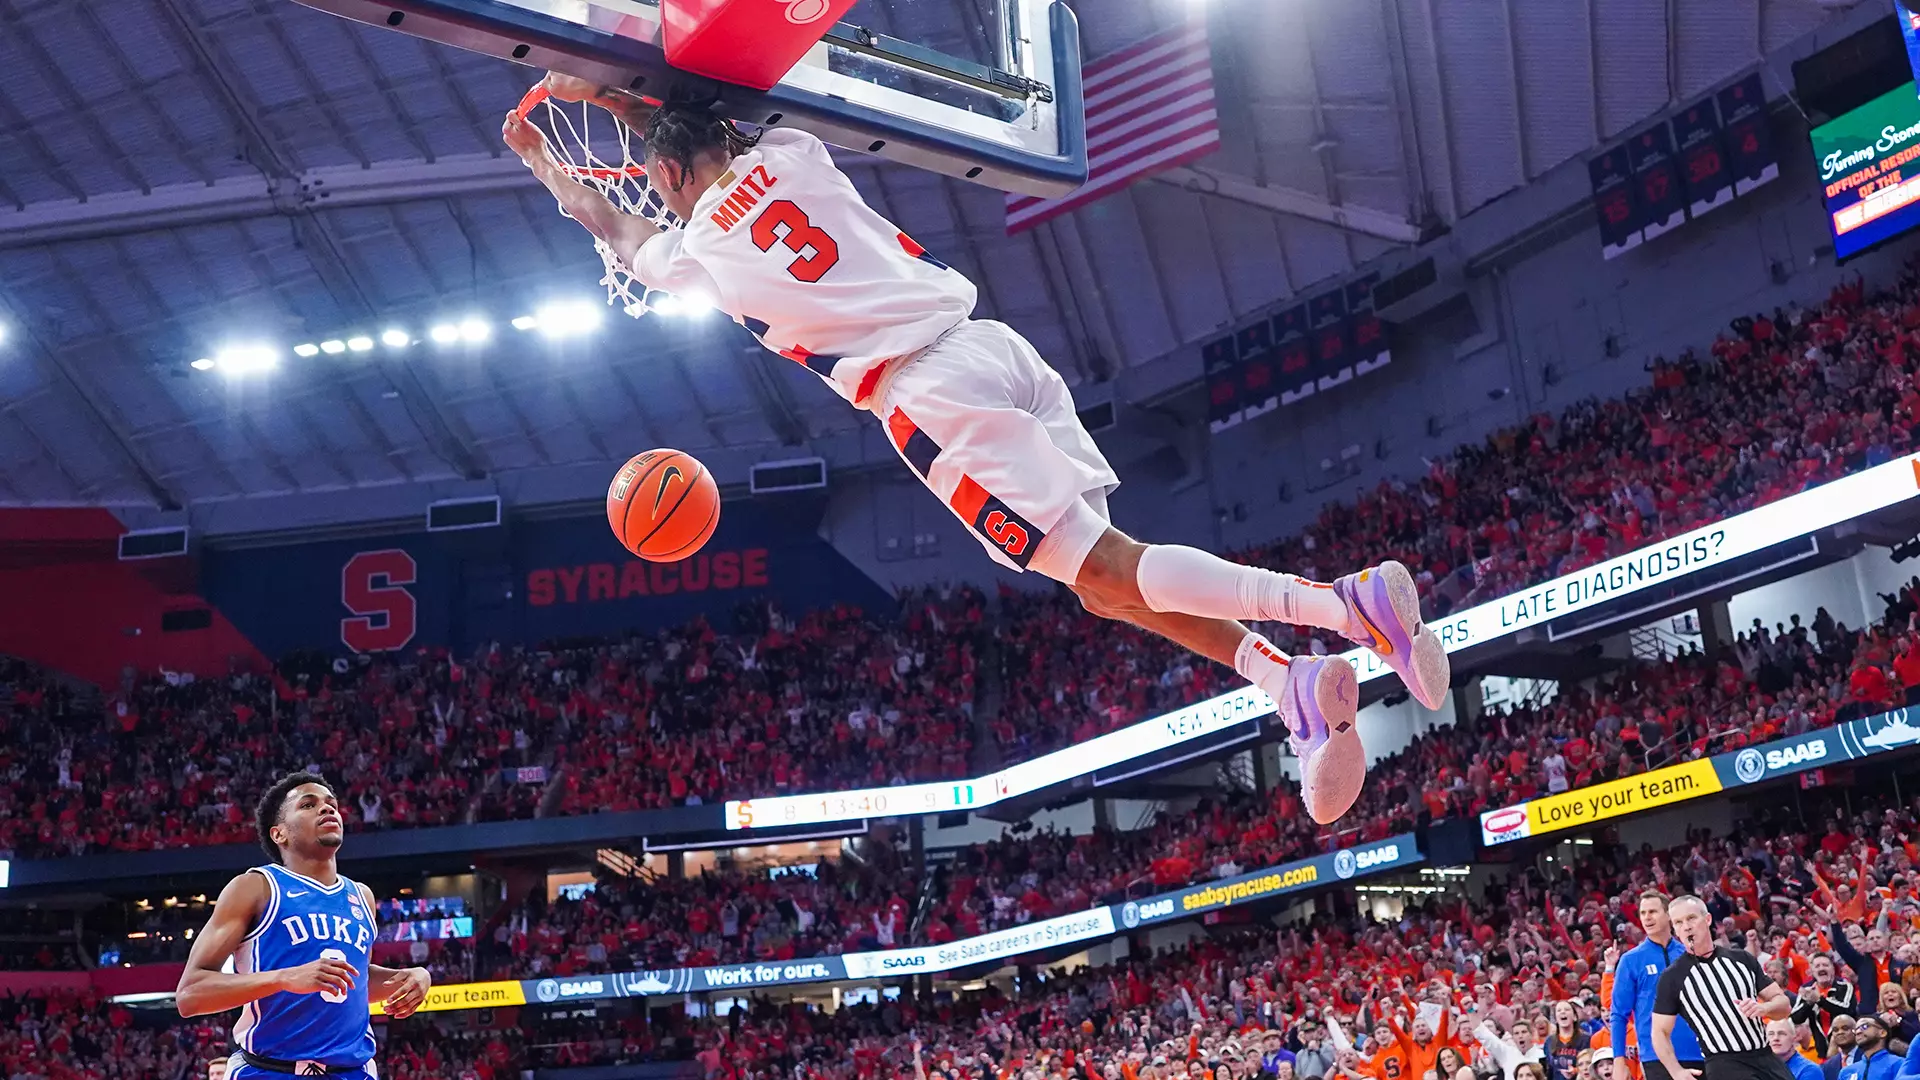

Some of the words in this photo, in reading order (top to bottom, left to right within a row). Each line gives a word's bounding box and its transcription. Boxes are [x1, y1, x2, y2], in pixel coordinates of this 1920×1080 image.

[1821, 149, 1875, 180] Turning
[1825, 165, 1880, 198] OFFICIAL
[1858, 182, 1875, 198] OF
[1875, 169, 1902, 189] THE
[711, 165, 778, 233] MINTZ
[750, 200, 839, 283] 3
[612, 452, 658, 501] ELITE
[984, 510, 1029, 555] S
[341, 548, 417, 653] S
[527, 549, 769, 606] SYRACUSE
[1166, 713, 1203, 737] NEW
[1210, 696, 1257, 721] YORK
[1501, 588, 1557, 627] LATE
[1567, 530, 1725, 606] DIAGNOSIS?
[1766, 739, 1828, 770] SAAB
[1538, 801, 1584, 825] Love
[1589, 788, 1634, 818] your
[1640, 774, 1700, 800] team.
[1355, 844, 1400, 870] SAAB
[1138, 898, 1175, 921] SAAB
[1182, 864, 1318, 911] saabsyracuse.com
[281, 913, 370, 955] DUKE
[882, 954, 926, 970] SAAB
[937, 949, 958, 965] See
[959, 942, 988, 960] Saab
[988, 932, 1031, 954] careers
[423, 991, 457, 1009] your
[464, 988, 510, 1003] team.
[559, 980, 604, 997] SAAB
[704, 965, 754, 987] Work
[754, 965, 783, 983] for
[783, 962, 830, 980] ours.
